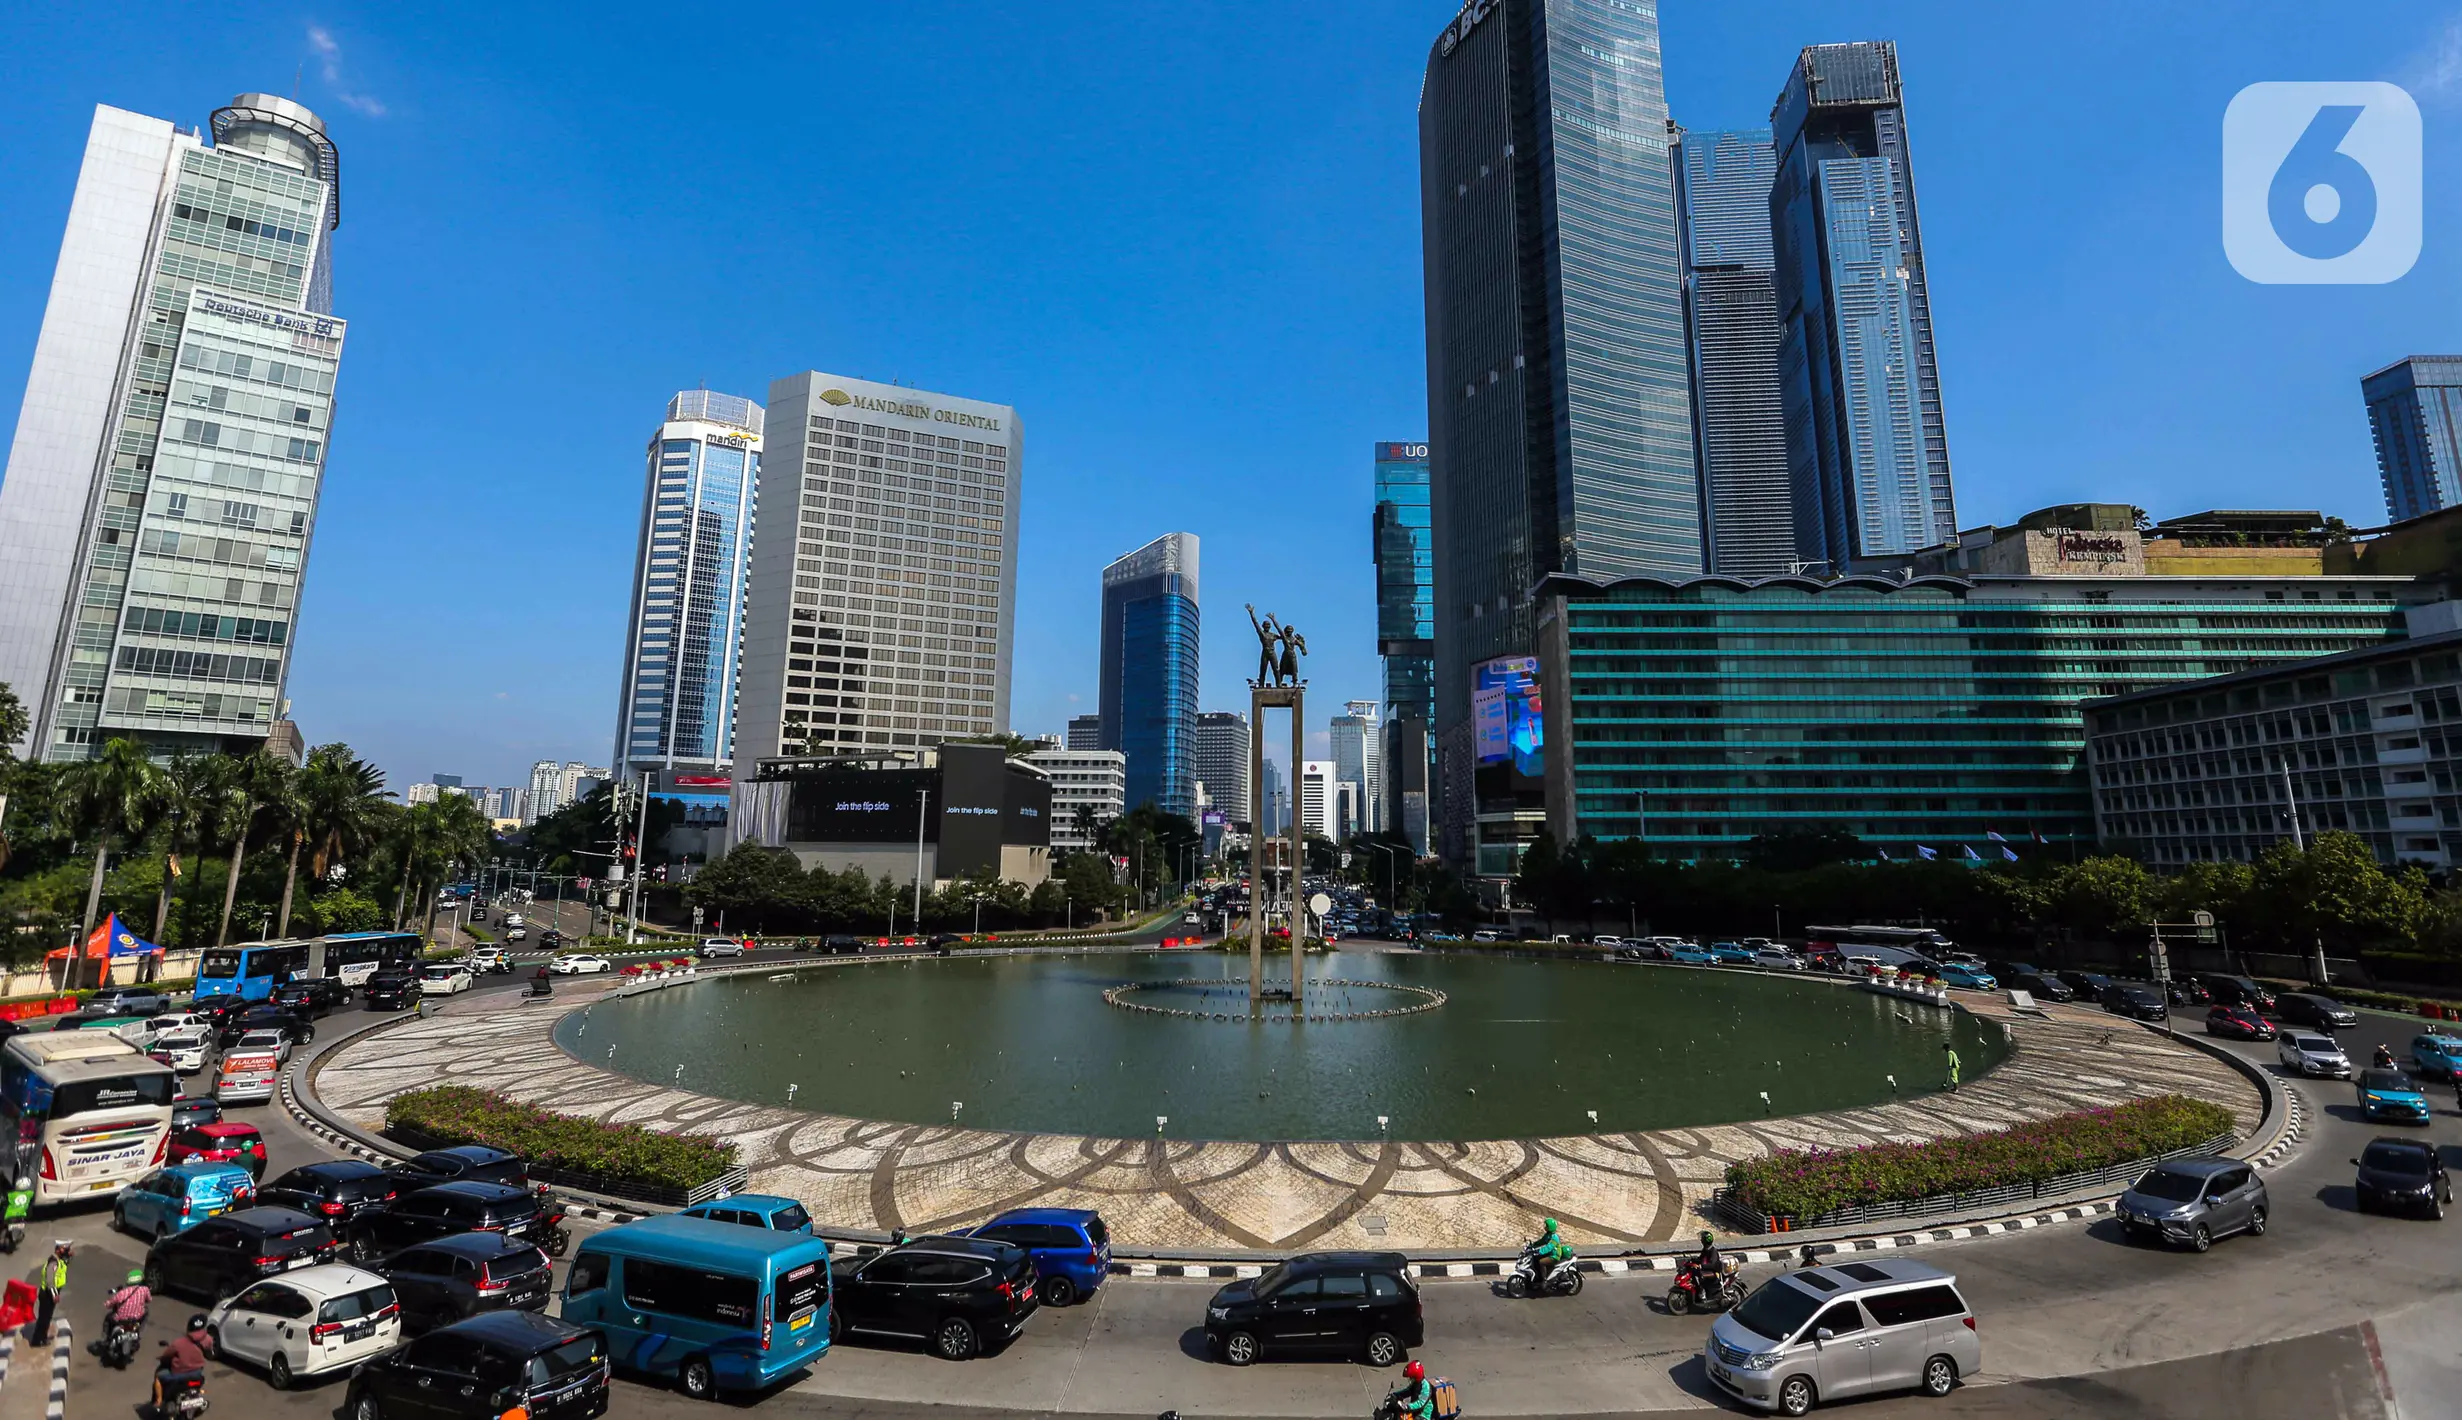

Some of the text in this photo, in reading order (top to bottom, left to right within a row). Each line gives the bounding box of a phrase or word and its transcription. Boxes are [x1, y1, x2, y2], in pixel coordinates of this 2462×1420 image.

[206, 299, 308, 330] Deutsche Bank
[853, 395, 1001, 431] MANDARIN ORIENTAL
[707, 432, 747, 448] mandiri
[1405, 445, 1428, 457] UO
[2046, 527, 2074, 535] HOTEL
[835, 801, 890, 813] Join the flip side
[946, 806, 960, 814] Join
[973, 807, 983, 815] flip
[984, 807, 998, 815] side
[67, 1154, 110, 1166] SINAR
[114, 1148, 146, 1160] JAYA
